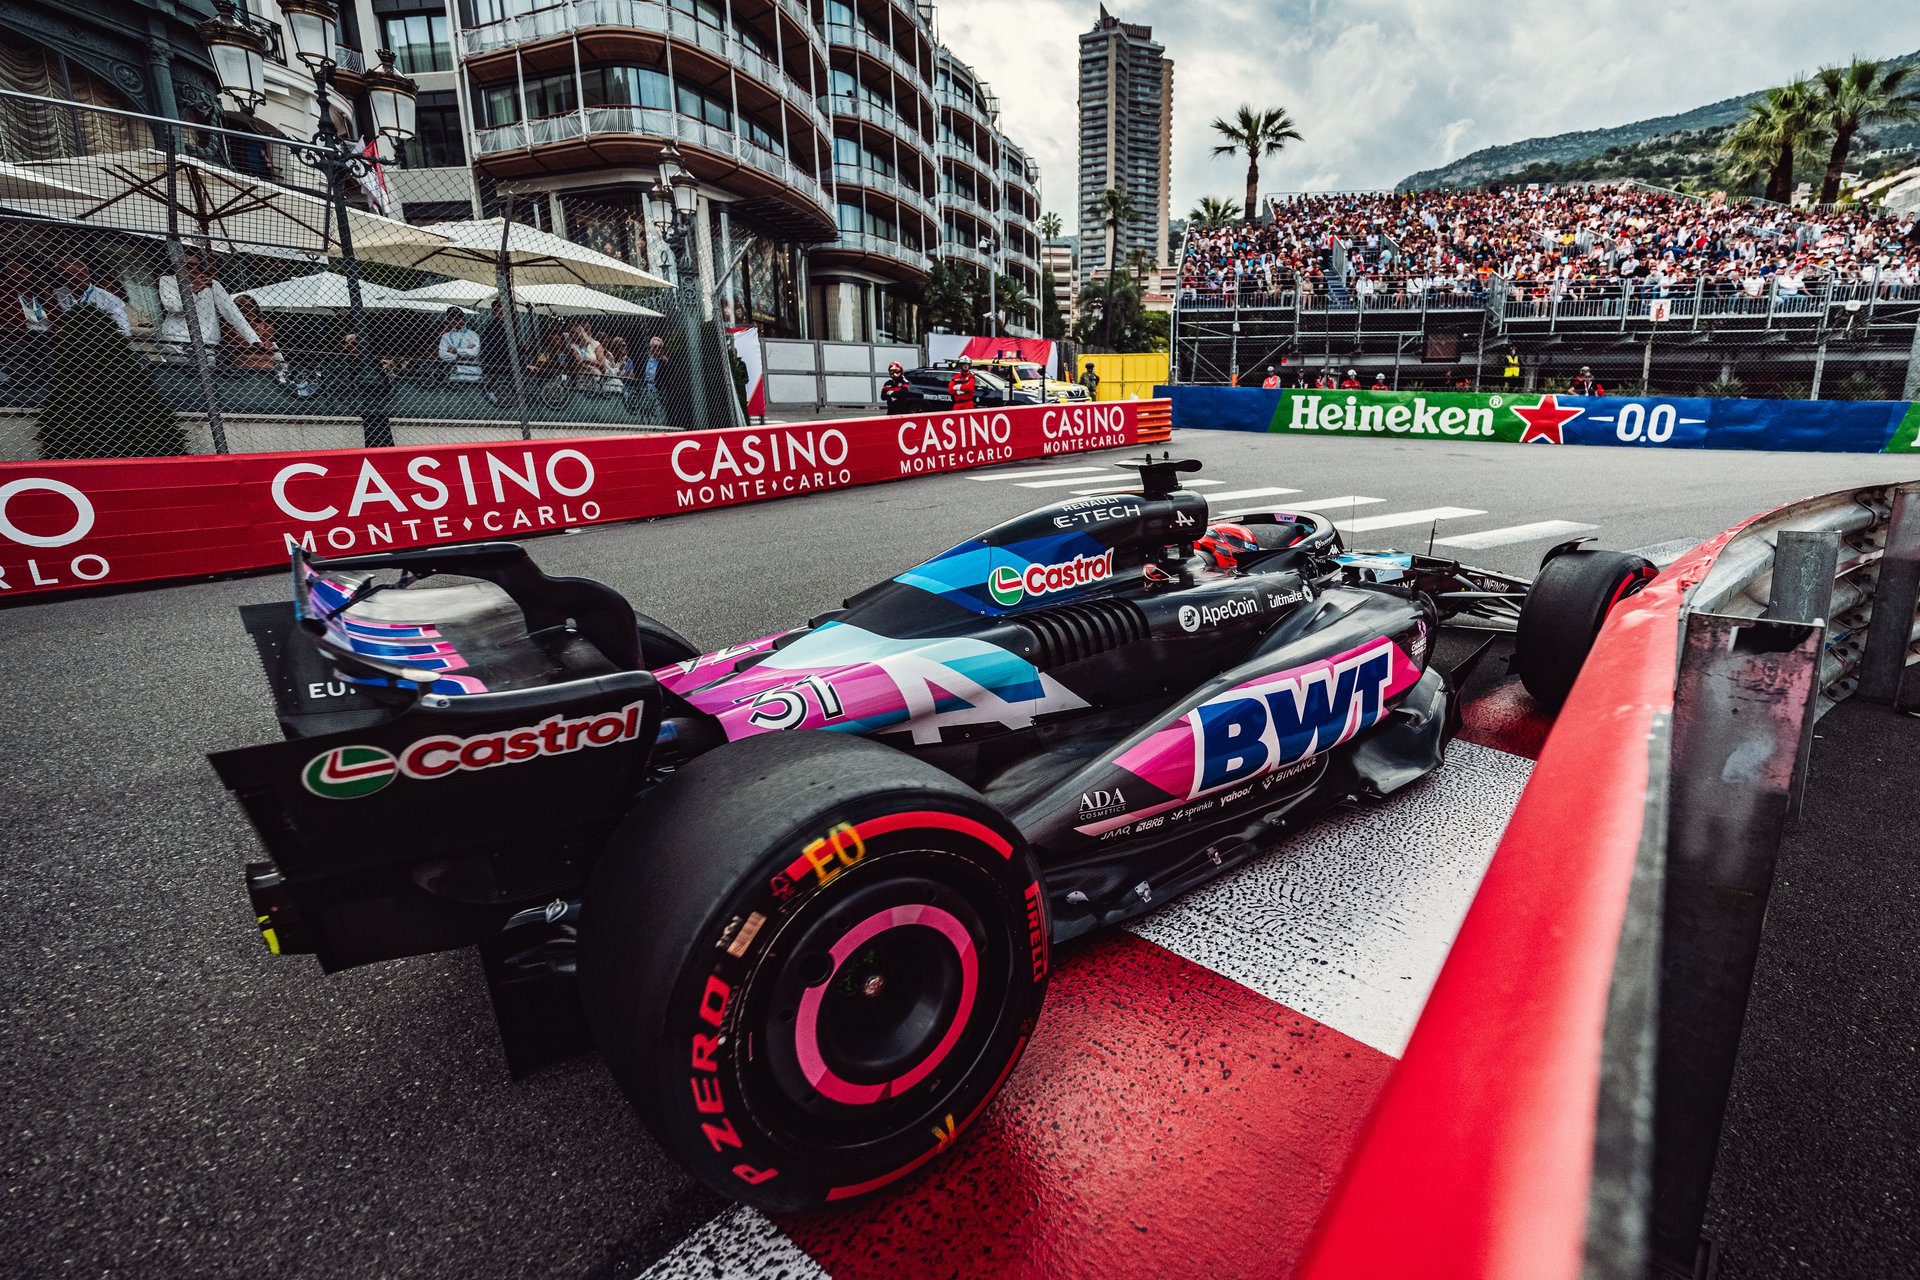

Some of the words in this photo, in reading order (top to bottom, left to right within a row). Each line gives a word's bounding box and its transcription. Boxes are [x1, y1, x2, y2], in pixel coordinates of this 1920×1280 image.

[897, 413, 1011, 455] CASINO
[1042, 405, 1125, 439] CASINO
[1616, 403, 1676, 443] 0.0
[671, 428, 849, 483] CASINO
[900, 452, 956, 474] MONTE
[966, 445, 1013, 464] CARLO
[1043, 438, 1084, 454] MONTE
[1091, 433, 1126, 448] CARLO
[271, 449, 595, 522] CASINO
[676, 479, 766, 507] MONTE
[782, 468, 851, 492] CARLO
[1063, 497, 1120, 512] RENAULT
[283, 516, 453, 555] MONTE
[483, 501, 601, 532] CARLO
[1054, 505, 1141, 529] E-TECH
[1025, 549, 1114, 595] Castrol
[1202, 597, 1258, 626] ApeCoin
[1269, 591, 1303, 608] ultimate
[732, 674, 845, 730] 31
[1192, 646, 1392, 797] BWT
[404, 703, 642, 778] Castrol
[1275, 757, 1317, 783] BINANCE
[1079, 787, 1126, 812] ADA
[1080, 805, 1126, 821] COSMETICS
[1184, 800, 1214, 817] sprinklr
[1024, 880, 1049, 983] PIRELLI
[692, 974, 743, 1153] ZERO
